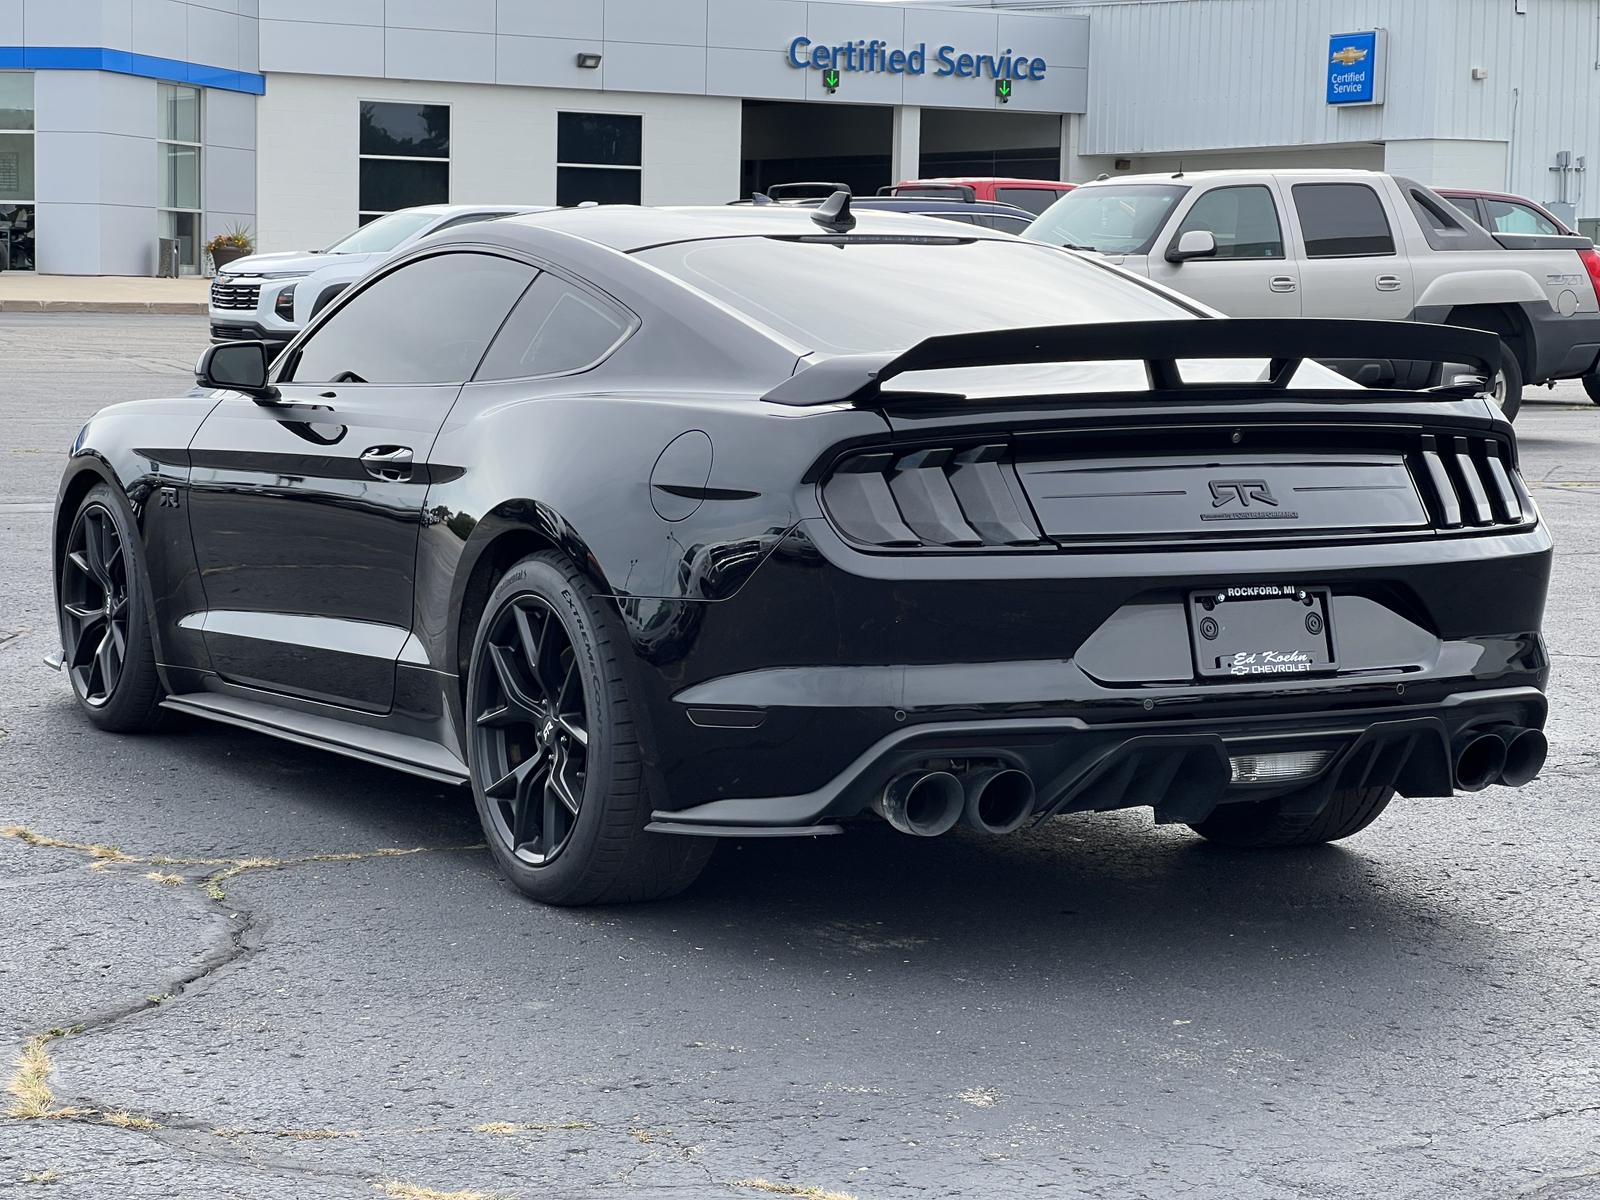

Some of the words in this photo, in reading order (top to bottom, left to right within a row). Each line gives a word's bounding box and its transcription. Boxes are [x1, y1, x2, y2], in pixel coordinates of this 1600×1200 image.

[788, 36, 926, 75] Certified
[936, 46, 1047, 81] Service
[1331, 71, 1366, 84] Certified
[1333, 82, 1362, 94] Service
[1227, 586, 1282, 597] ROCKFORD,
[1283, 585, 1295, 595] MI
[1233, 652, 1256, 666] Ed
[1262, 650, 1308, 663] Koehn
[1251, 663, 1312, 675] CHEVROLET
